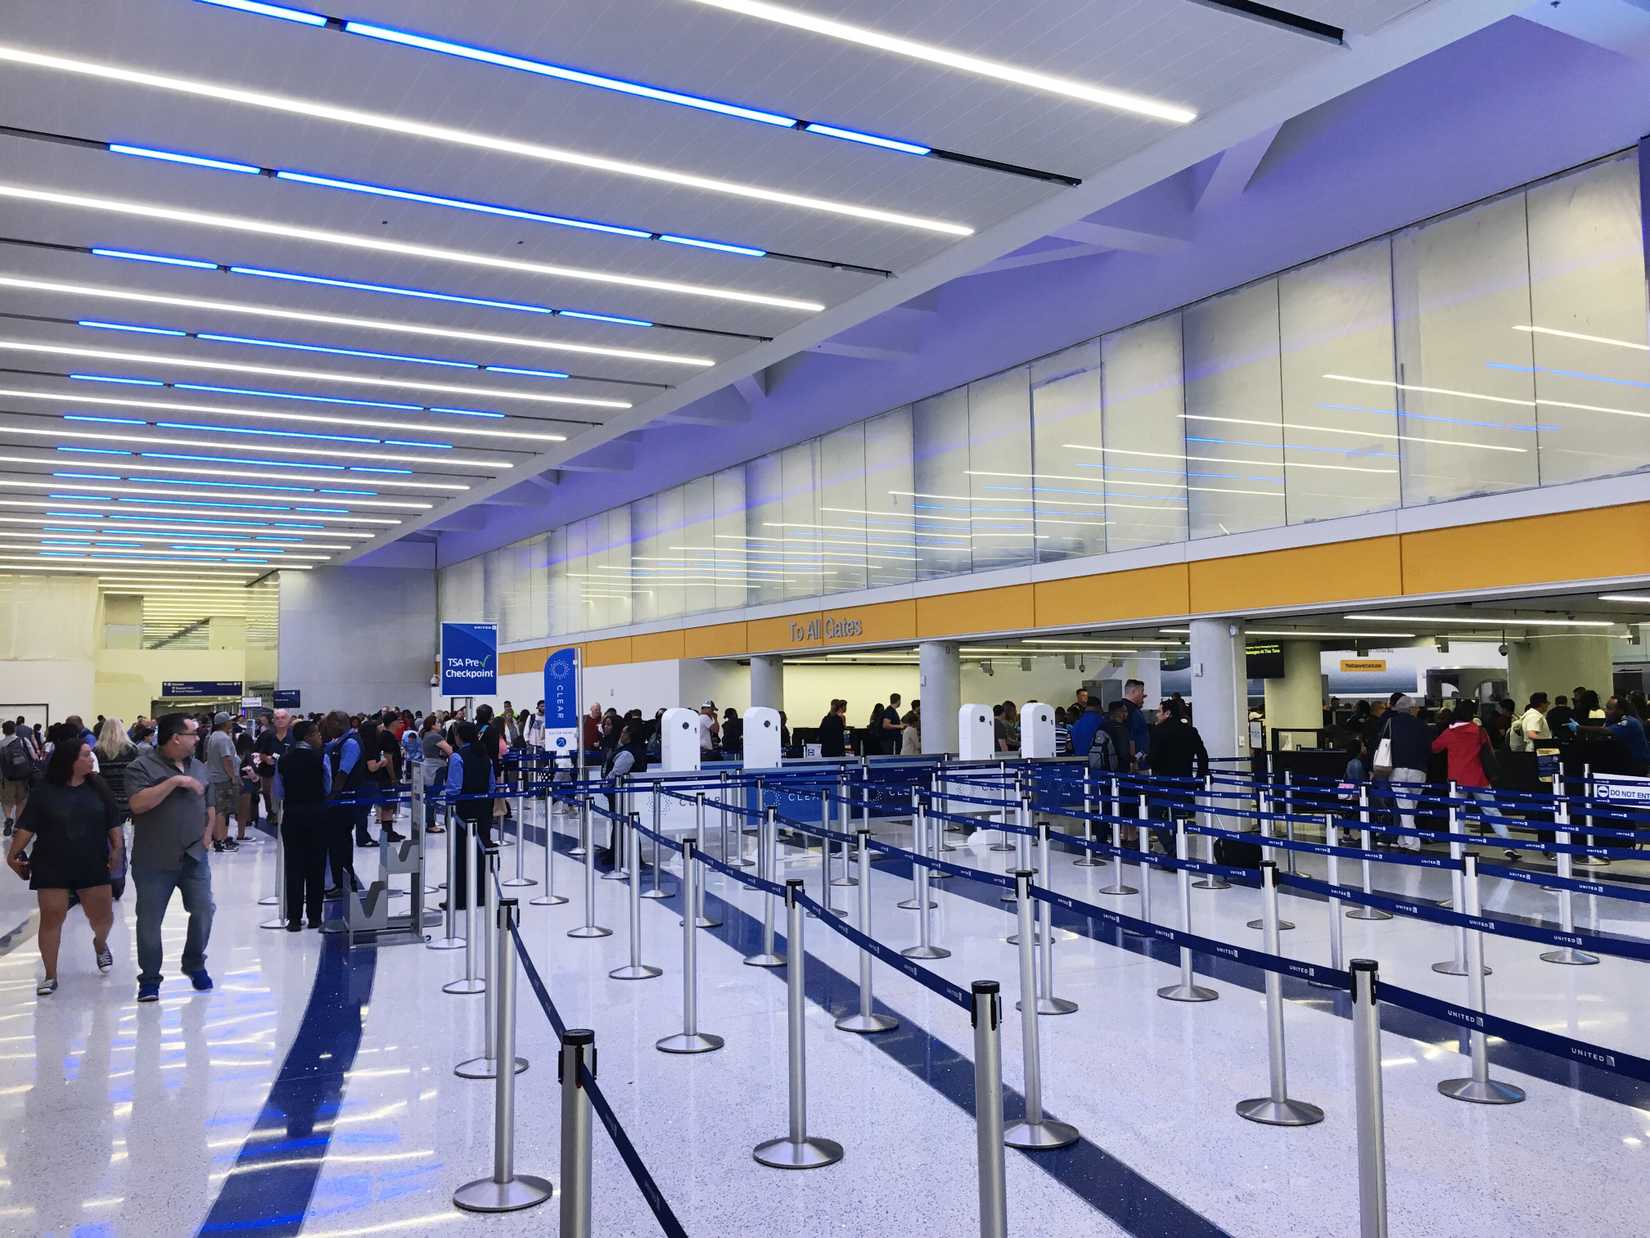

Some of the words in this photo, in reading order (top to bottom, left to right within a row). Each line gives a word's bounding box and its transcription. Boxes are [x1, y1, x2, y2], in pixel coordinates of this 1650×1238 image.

[789, 621, 804, 642] To
[807, 618, 822, 640] All
[825, 616, 863, 639] Gates
[448, 658, 463, 667] TSA
[465, 658, 480, 667] Pre
[445, 668, 494, 679] Checkpoint
[556, 684, 564, 719] CLEAR
[1610, 789, 1621, 797] DO
[1622, 790, 1636, 798] NOT
[1469, 919, 1489, 927] UNITED
[1553, 935, 1576, 943] UNITED
[1289, 965, 1309, 974] UNITED
[1447, 1010, 1476, 1023] UNITED
[1571, 1047, 1605, 1063] UNITED
